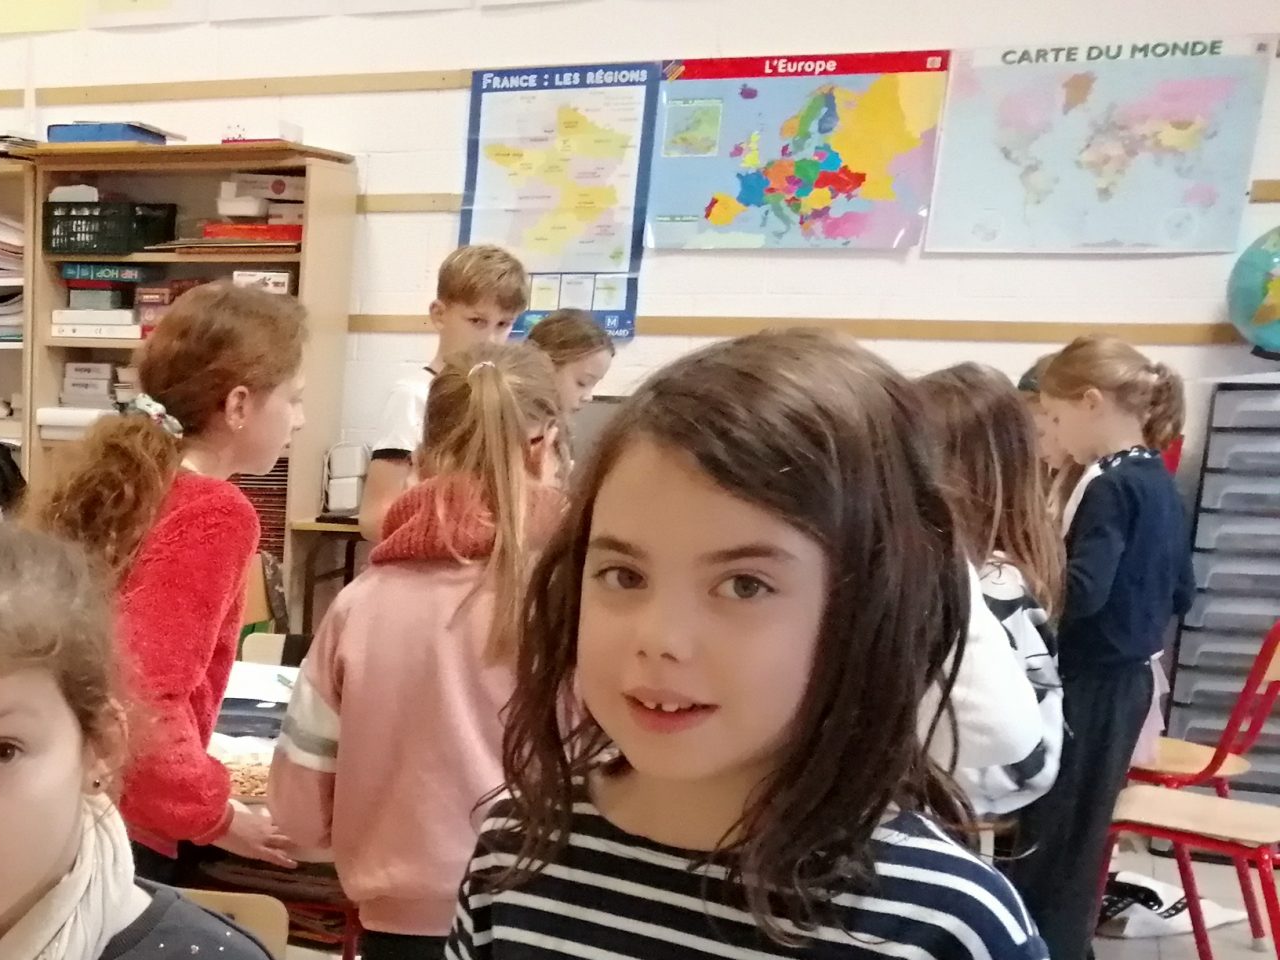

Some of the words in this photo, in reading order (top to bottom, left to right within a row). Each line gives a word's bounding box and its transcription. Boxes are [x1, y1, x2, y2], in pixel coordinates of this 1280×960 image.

[1001, 45, 1078, 65] CARTE
[1086, 44, 1123, 61] DU
[1129, 40, 1224, 59] MONDE
[764, 58, 838, 76] L'Europe
[554, 72, 580, 87] LES
